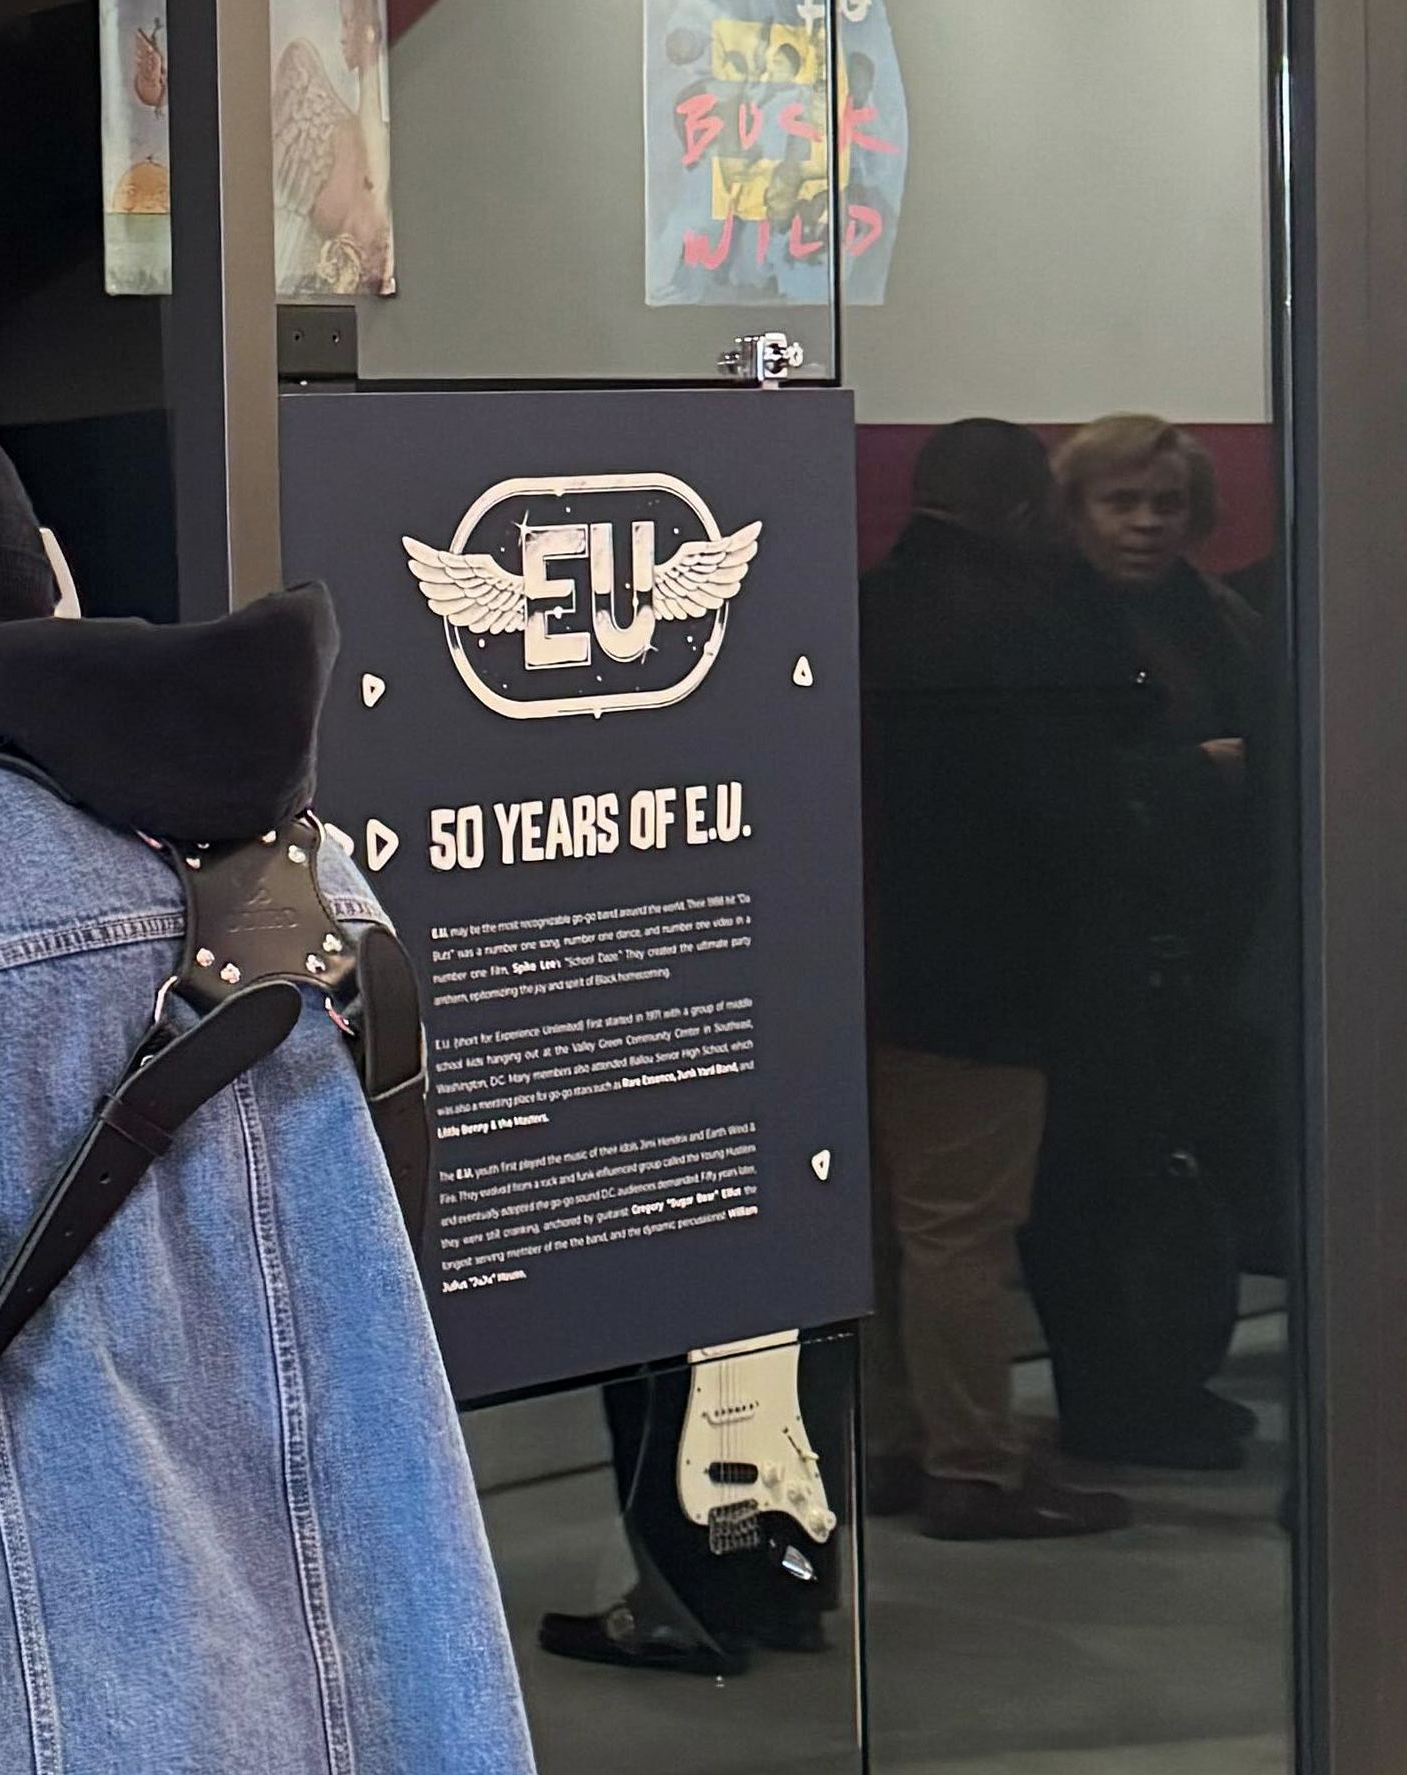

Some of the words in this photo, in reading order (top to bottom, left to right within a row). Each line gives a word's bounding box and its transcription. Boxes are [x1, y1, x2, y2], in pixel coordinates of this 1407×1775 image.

[674, 93, 900, 168] BUCK
[684, 205, 884, 271] WILD
[521, 521, 656, 671] EU
[428, 803, 485, 872] 50
[493, 791, 620, 866] YEARS
[629, 787, 676, 849] OF
[685, 781, 752, 846] E.U.
